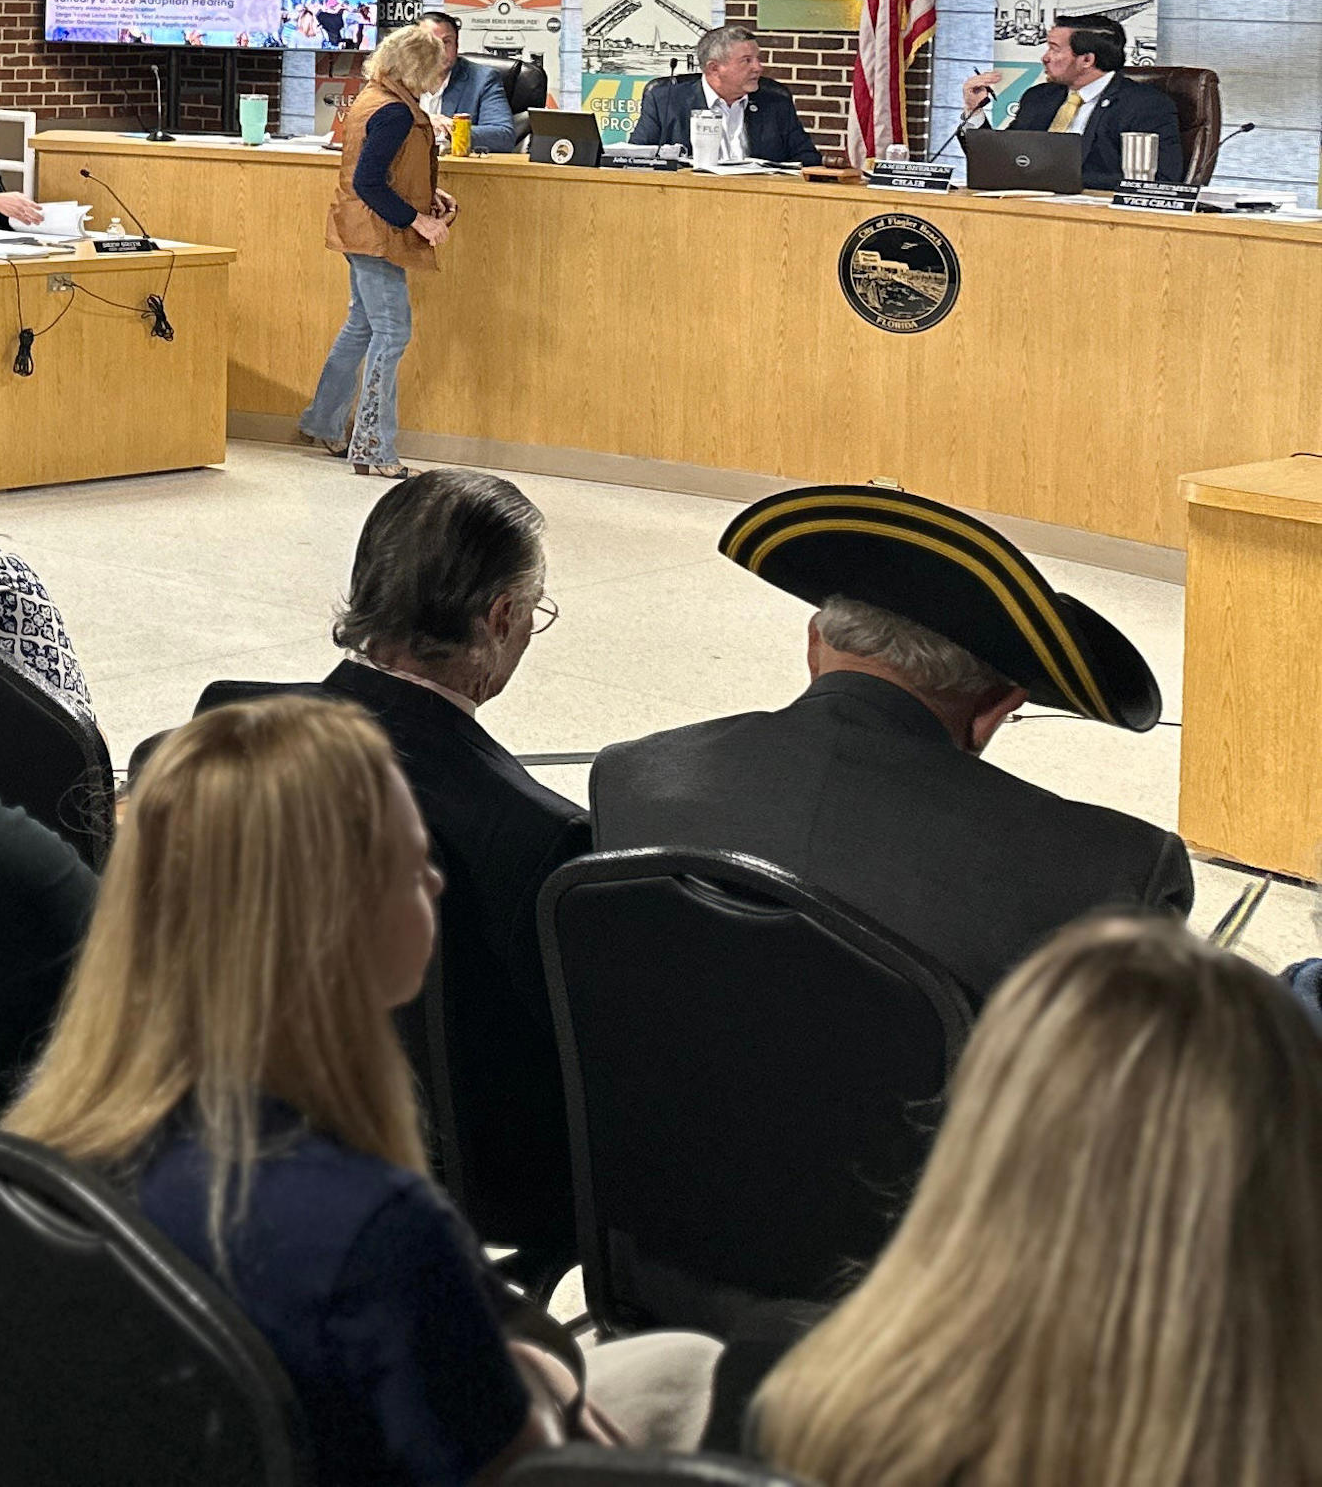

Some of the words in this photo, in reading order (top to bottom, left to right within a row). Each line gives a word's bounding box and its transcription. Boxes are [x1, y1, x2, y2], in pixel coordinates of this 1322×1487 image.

[379, 2, 423, 22] BEACH
[891, 178, 926, 188] CHAIR
[1123, 197, 1148, 207] VICE
[1149, 199, 1185, 210] CHAIR
[858, 224, 875, 239] City
[876, 219, 885, 228] of
[888, 218, 918, 229] Flagler
[919, 224, 943, 247] Beach
[876, 316, 919, 330] FLORIDA
